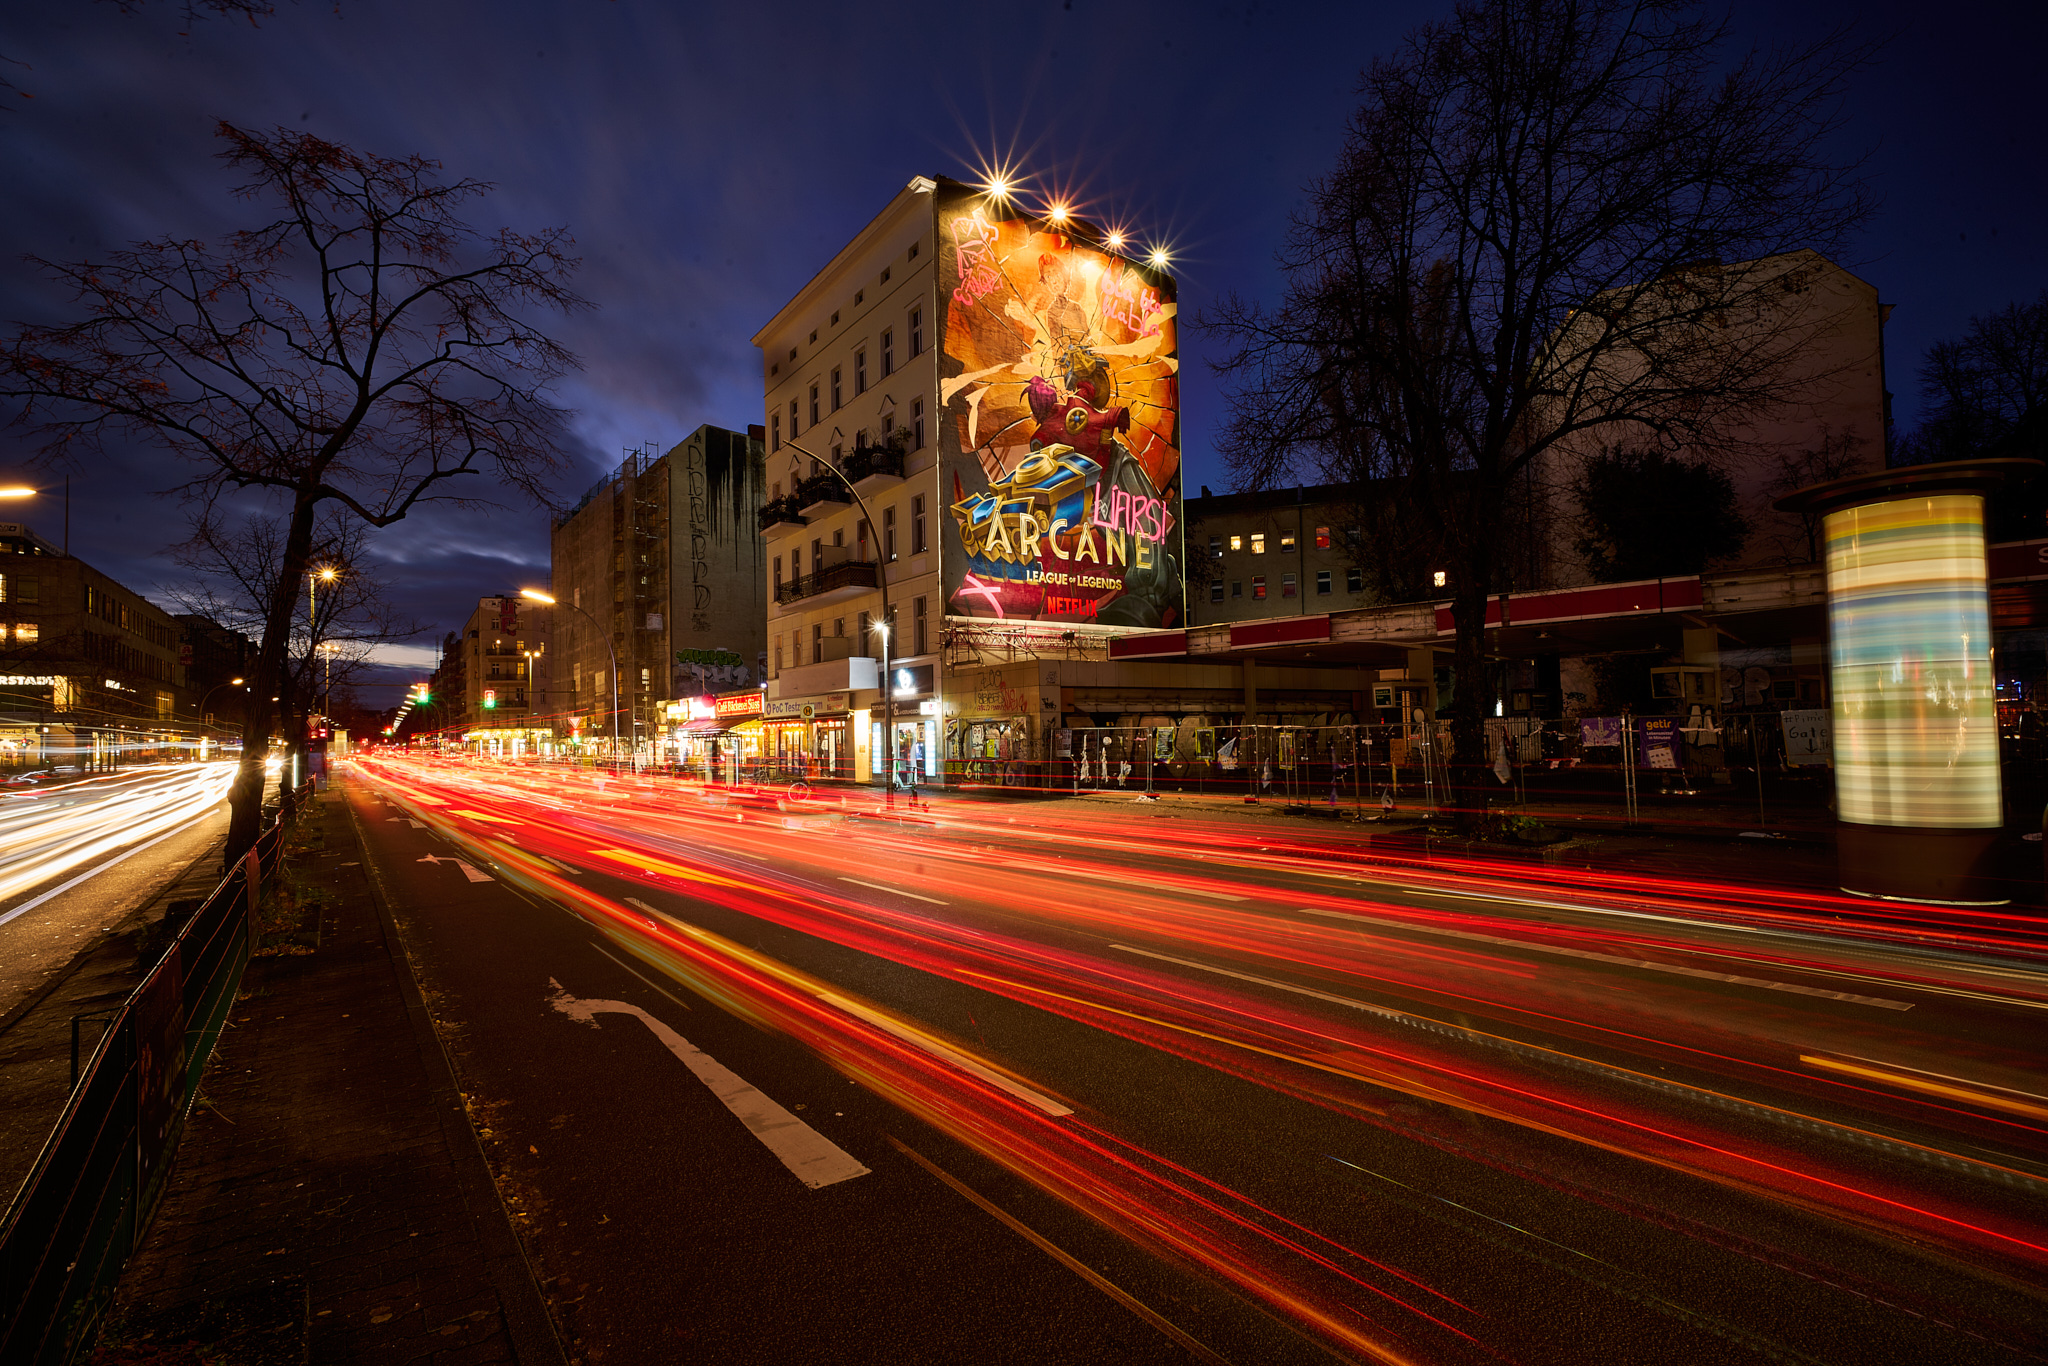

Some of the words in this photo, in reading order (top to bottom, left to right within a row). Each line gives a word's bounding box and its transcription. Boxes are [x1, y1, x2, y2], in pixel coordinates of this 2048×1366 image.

[985, 509, 1152, 570] ARCANE
[1026, 569, 1068, 585] LEAGUE
[1077, 575, 1122, 590] LEGENDS
[1047, 596, 1098, 618] NETFLIX
[772, 702, 783, 713] PoC
[1646, 719, 1672, 731] getir
[1789, 726, 1828, 739] Gate
